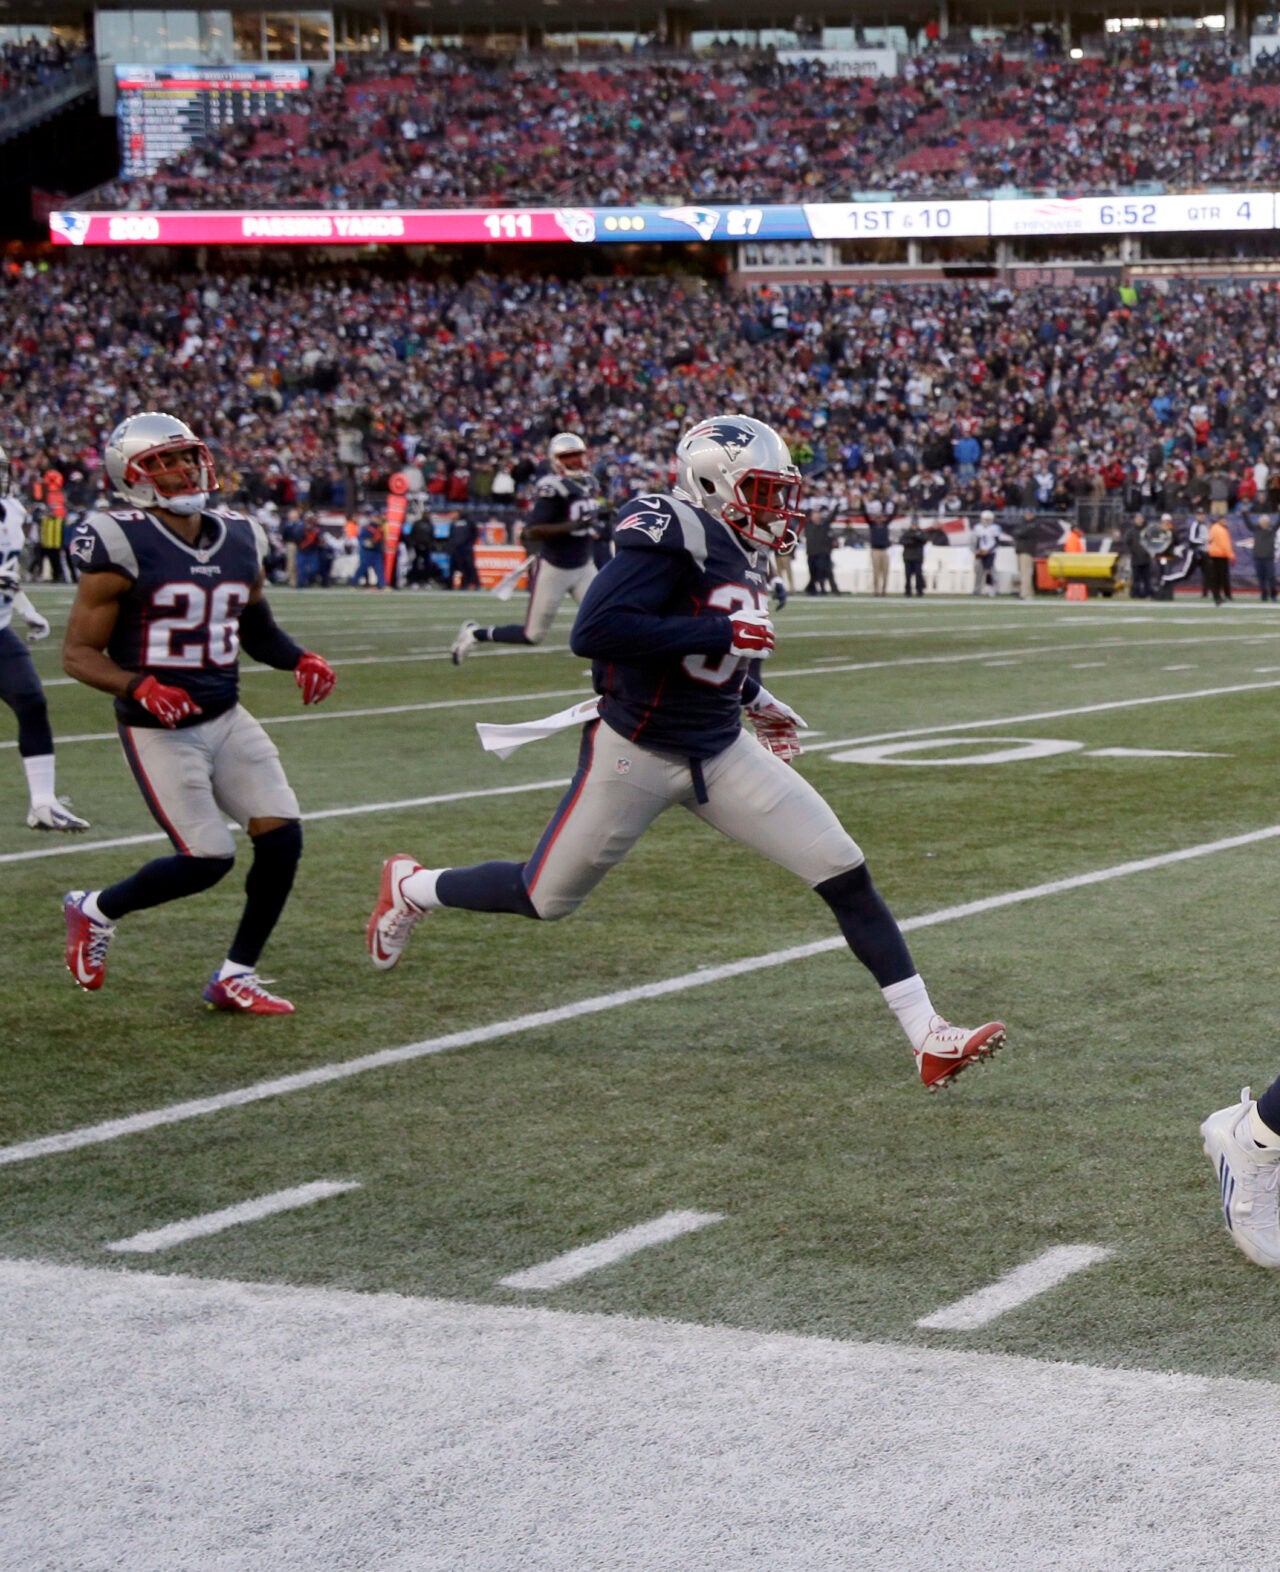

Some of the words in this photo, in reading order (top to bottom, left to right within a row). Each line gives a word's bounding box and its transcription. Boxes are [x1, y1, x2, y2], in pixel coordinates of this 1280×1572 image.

[726, 209, 763, 235] 27
[848, 210, 895, 231] 1ST
[918, 208, 951, 229] 10
[1100, 204, 1156, 225] 6:52
[1187, 207, 1221, 220] QTR
[1236, 201, 1252, 221] 4
[241, 217, 332, 237] PASSING
[333, 216, 405, 236] YARDS
[484, 214, 532, 238] 111
[146, 582, 251, 668] 26
